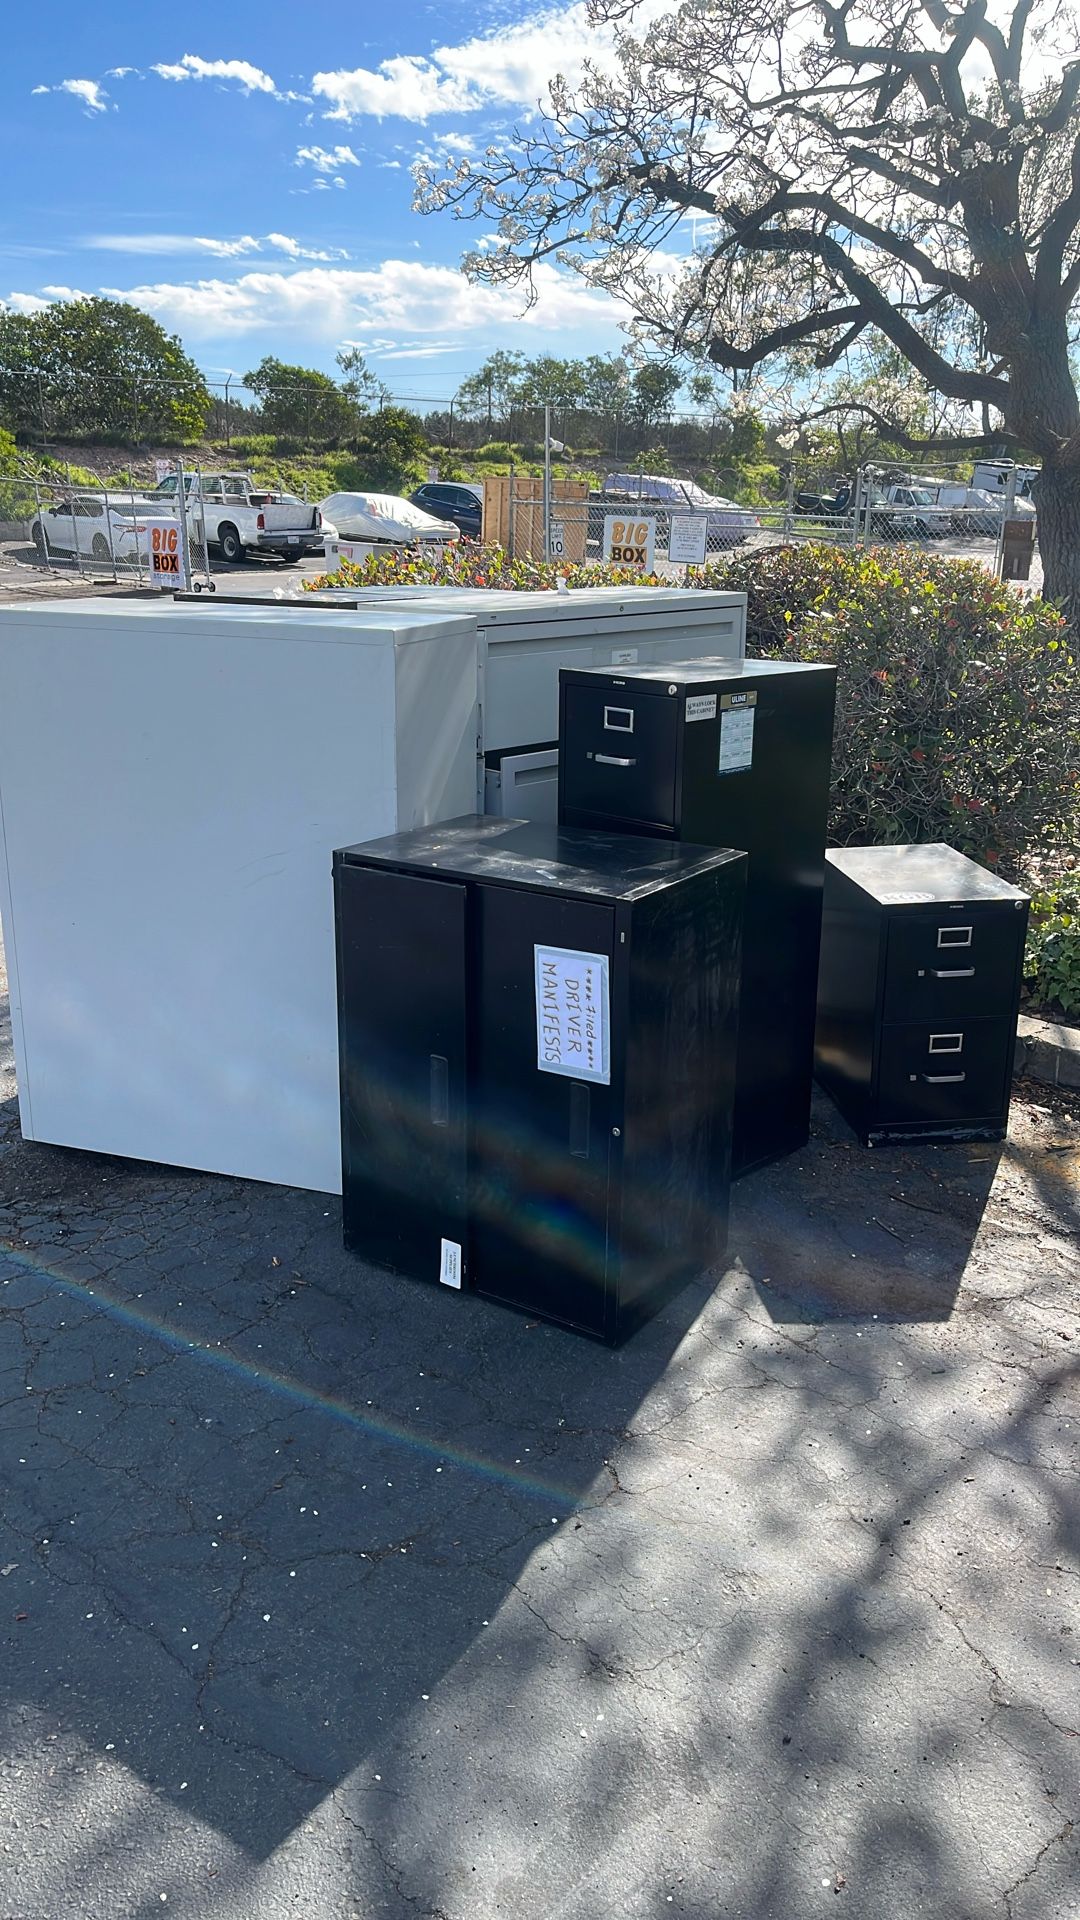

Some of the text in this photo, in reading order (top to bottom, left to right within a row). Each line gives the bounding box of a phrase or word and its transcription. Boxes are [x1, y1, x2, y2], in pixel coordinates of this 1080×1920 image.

[152, 528, 178, 552] BIG
[612, 522, 648, 545] BIG
[551, 541, 563, 552] 10
[612, 547, 645, 563] BOX
[153, 554, 178, 571] BOX
[153, 573, 180, 581] storage
[731, 695, 746, 703] ULINE
[542, 962, 561, 1064] MANIFESTS
[564, 978, 583, 1053] DRIVER
